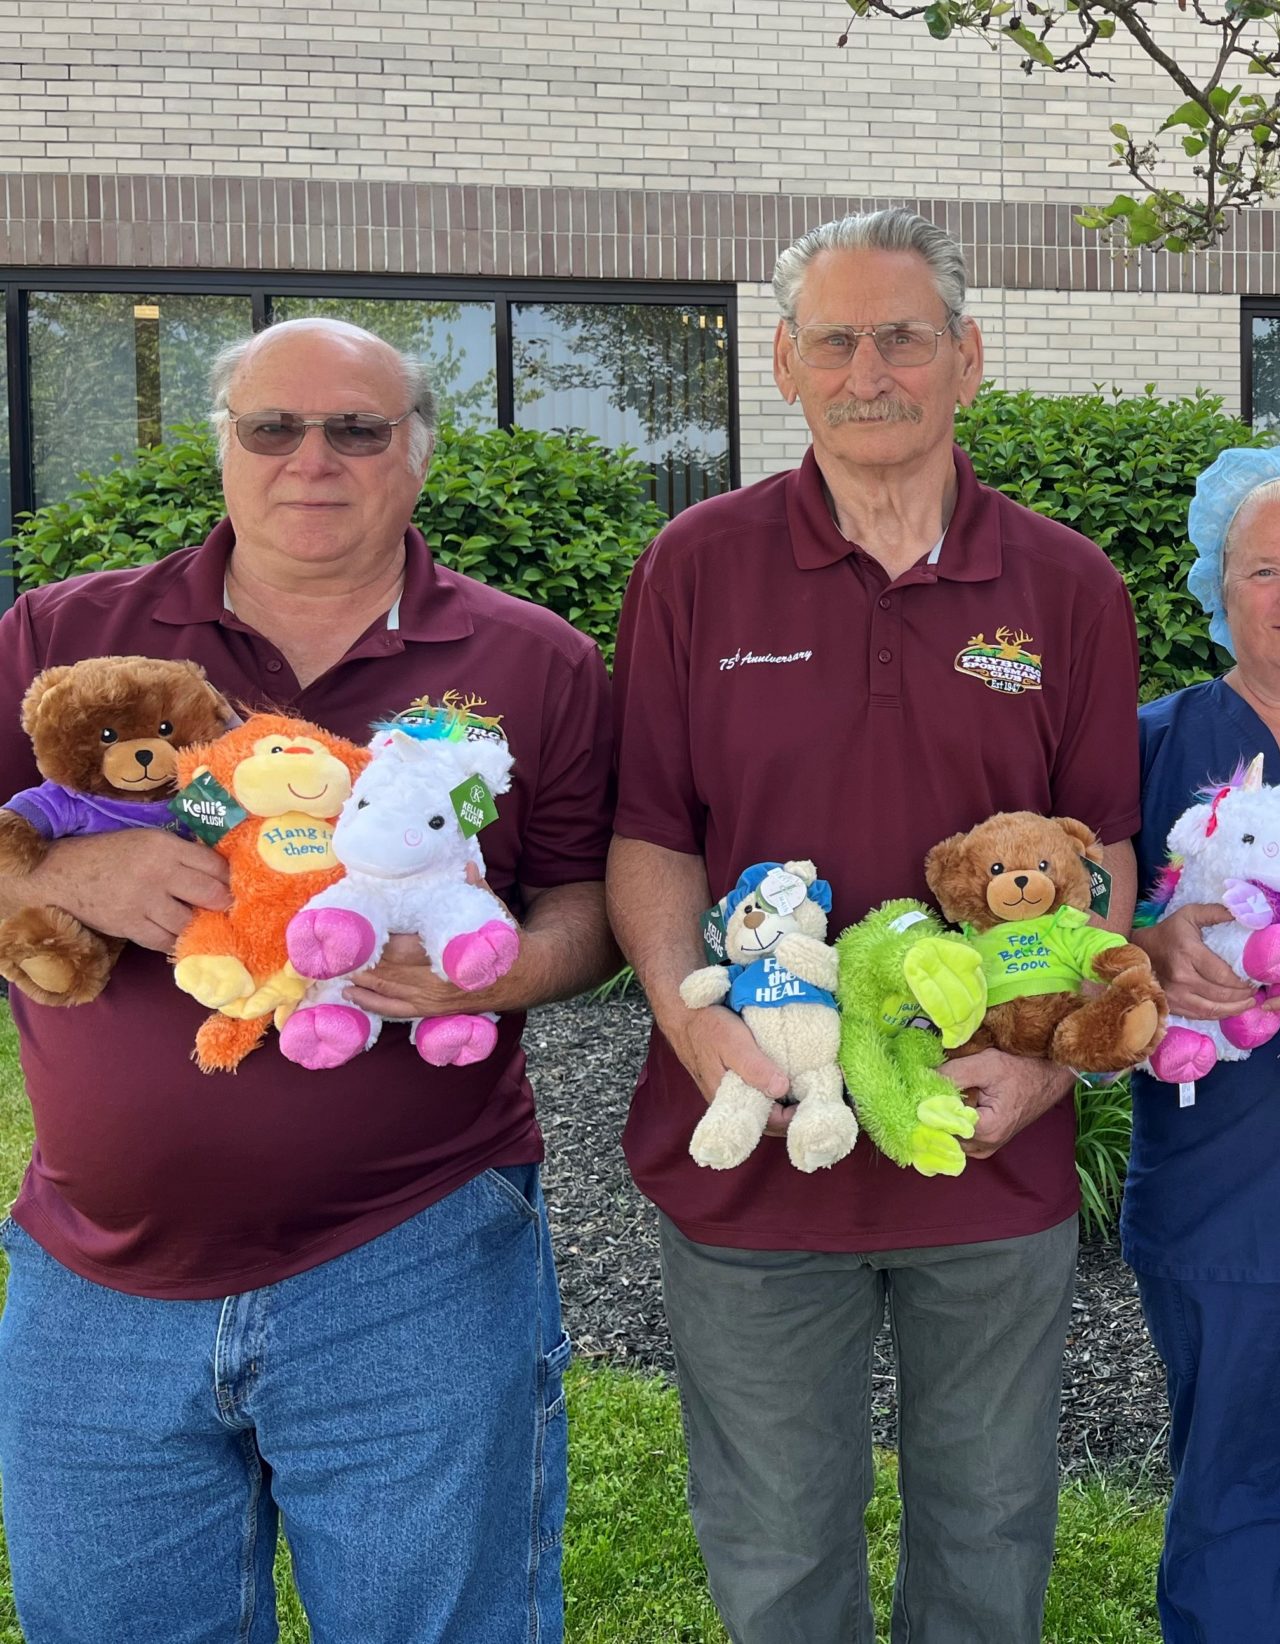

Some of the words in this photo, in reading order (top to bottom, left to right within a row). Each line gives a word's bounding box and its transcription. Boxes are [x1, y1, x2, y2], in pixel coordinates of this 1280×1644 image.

[739, 650, 813, 667] Anniversary
[990, 671, 1022, 682] CLUB
[182, 799, 227, 817] Kelli's
[201, 815, 224, 827] PLUSH
[461, 809, 481, 828] PLUSH
[264, 827, 317, 845] Hang
[1008, 932, 1039, 947] Feel
[1005, 960, 1050, 974] Soon
[755, 980, 806, 1002] HEAL
